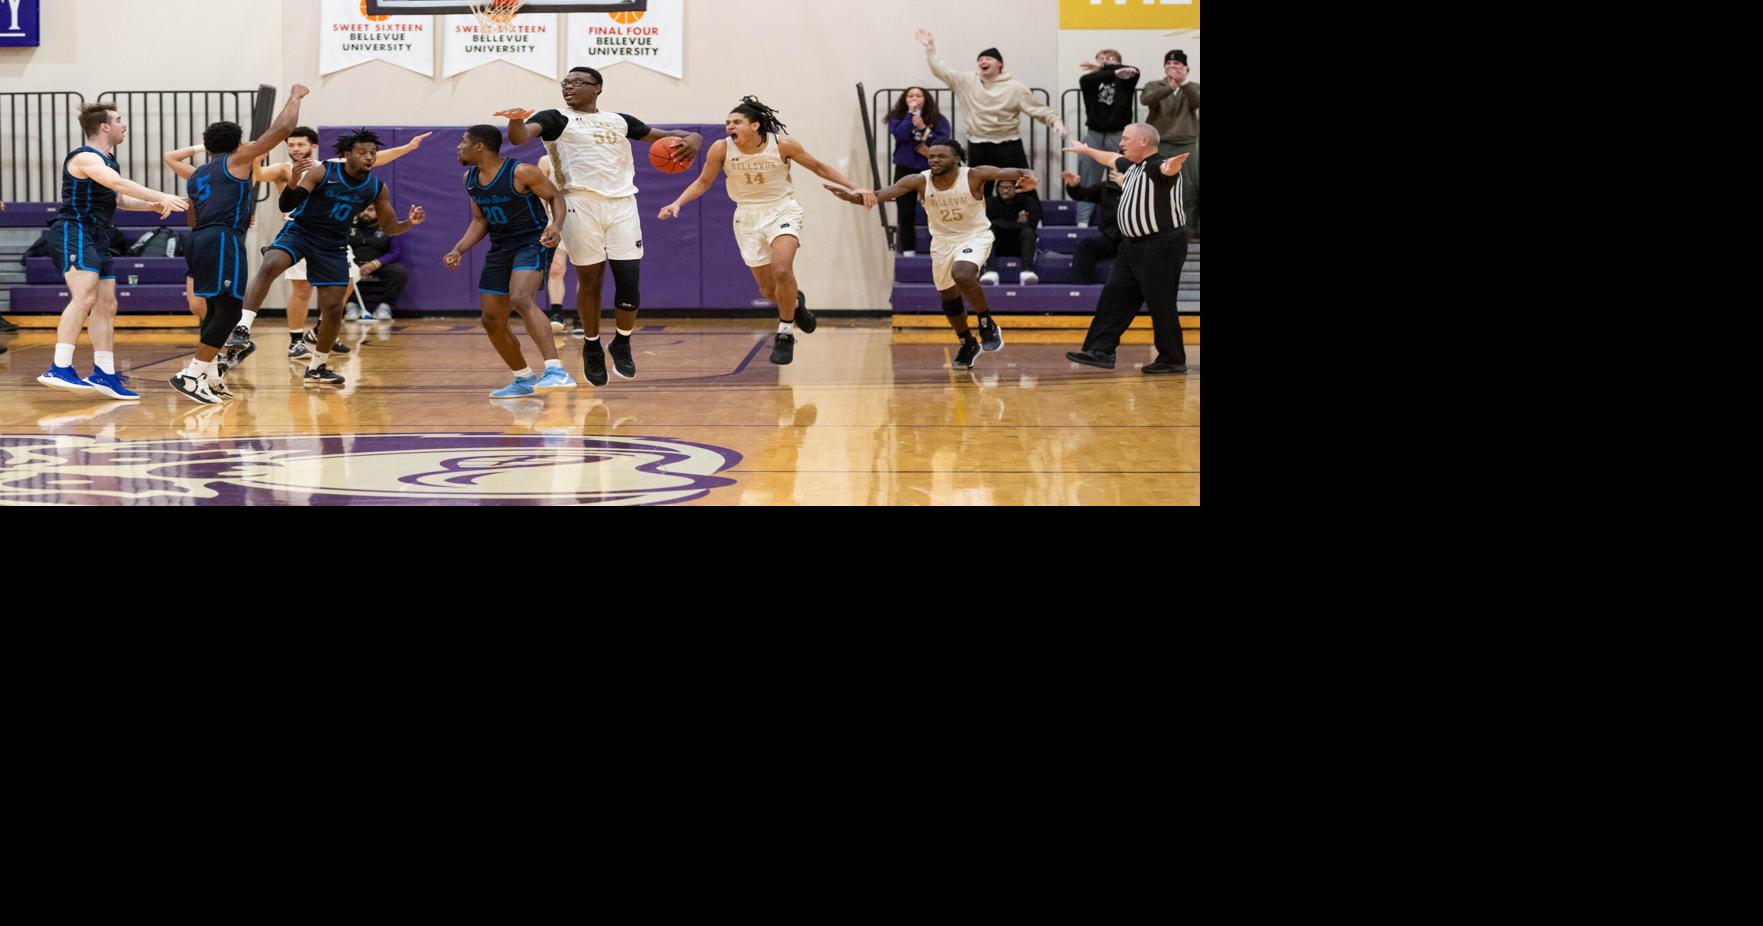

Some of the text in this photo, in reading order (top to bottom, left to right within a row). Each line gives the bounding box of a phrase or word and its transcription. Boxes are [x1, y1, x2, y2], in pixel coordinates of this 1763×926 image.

[332, 23, 423, 32] SWEET SIXTEEN
[455, 24, 492, 33] SWE
[588, 26, 659, 36] FINAL FOUR
[350, 32, 406, 41] BELLEVUE
[472, 34, 529, 43] BELLEVUE
[596, 36, 652, 46] BELLEVUE
[342, 43, 412, 52] UNIVERSITY
[465, 44, 536, 53] UNIVERSITY
[588, 47, 660, 56] UNIVERSITY
[592, 130, 617, 145] 50
[744, 172, 765, 185] 14
[196, 174, 212, 203] 5
[330, 203, 353, 222] 10
[481, 205, 509, 225] 20
[940, 208, 964, 222] 25
